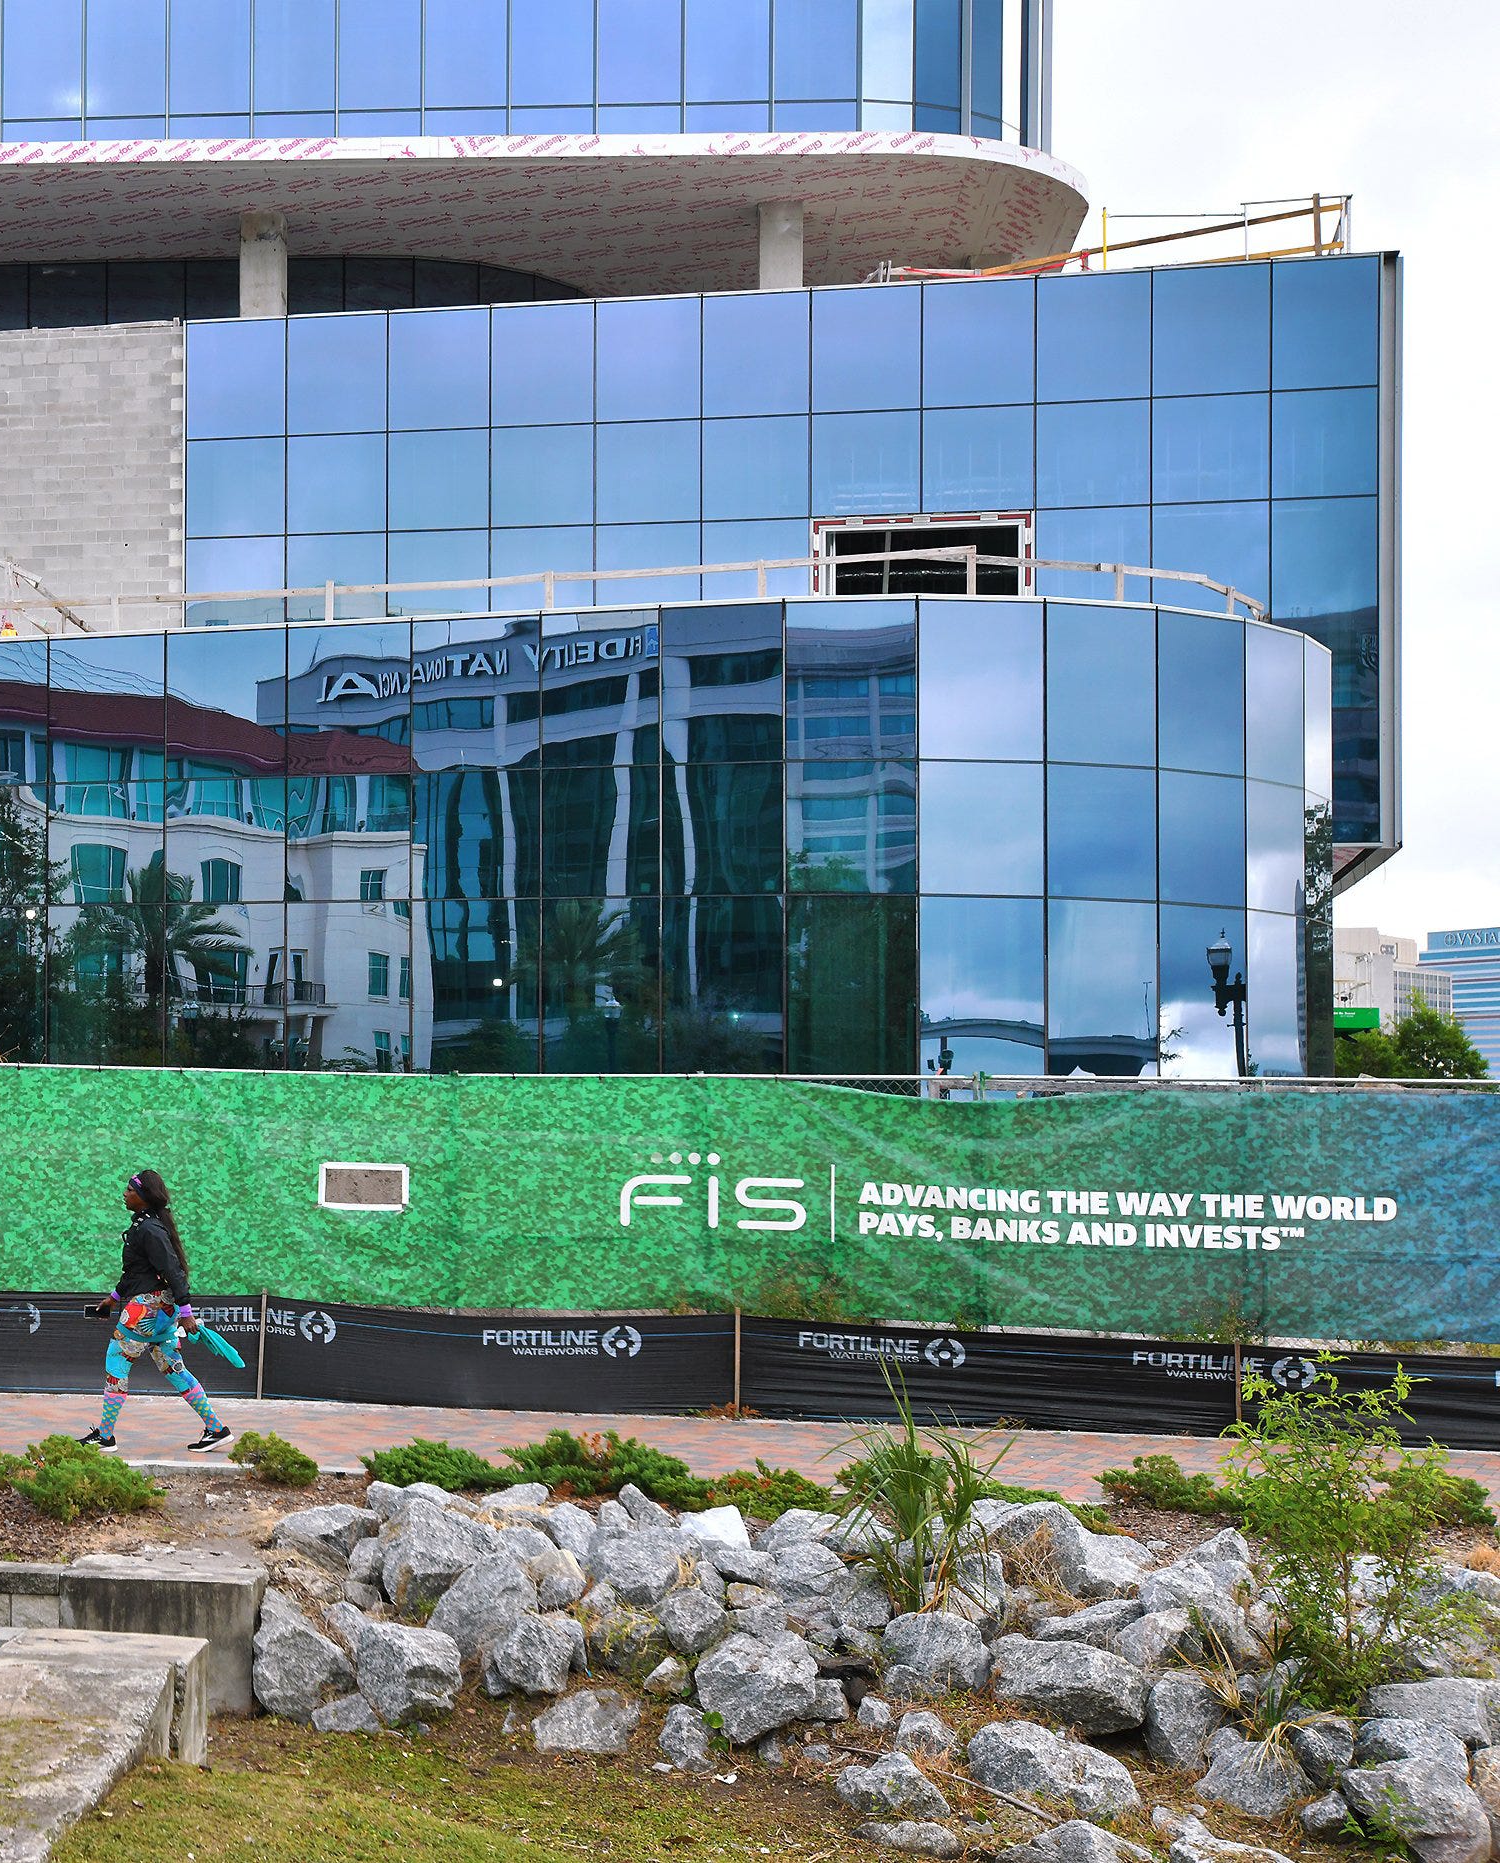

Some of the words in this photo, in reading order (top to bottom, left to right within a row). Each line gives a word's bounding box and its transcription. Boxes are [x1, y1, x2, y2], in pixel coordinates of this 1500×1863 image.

[858, 1181, 1040, 1213] ADVANCING
[1046, 1190, 1109, 1215] THE
[1115, 1191, 1194, 1217] WAY
[1200, 1193, 1265, 1219] THE
[1270, 1195, 1398, 1221] WORLD
[858, 1211, 944, 1242] PAYS,
[950, 1216, 1060, 1244] BANKS
[1066, 1221, 1138, 1247] AND
[191, 1306, 296, 1327] FORTILNE
[482, 1329, 599, 1346] FORTILINE
[798, 1331, 920, 1355] FORTILINE
[512, 1347, 599, 1356] WATERWORKS
